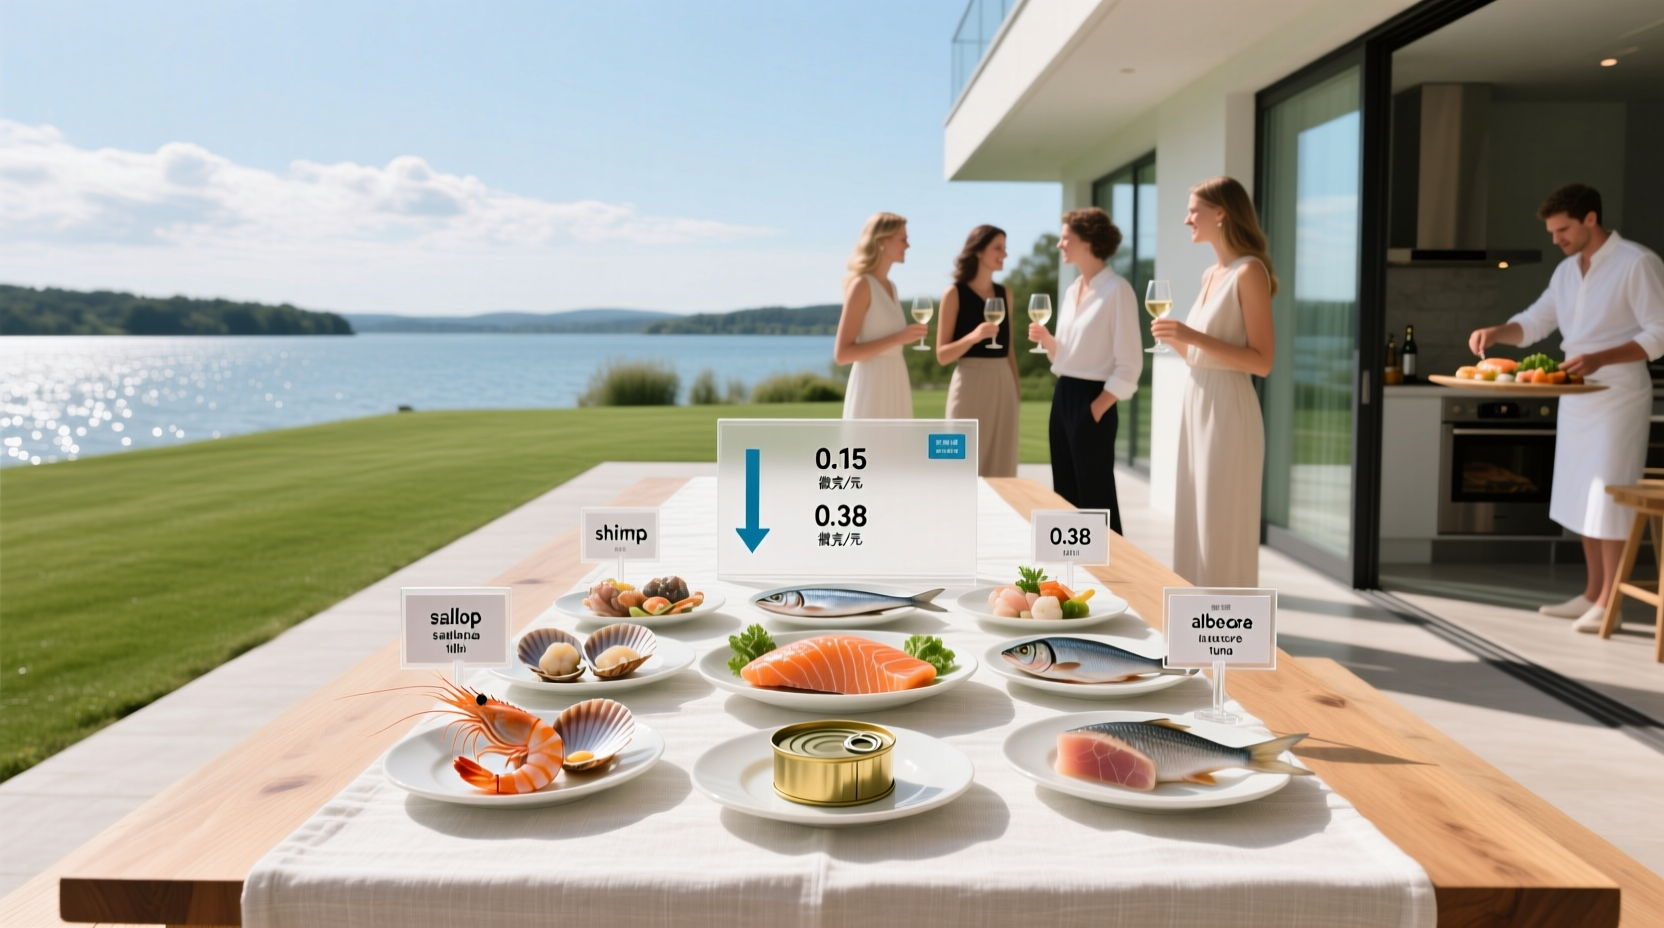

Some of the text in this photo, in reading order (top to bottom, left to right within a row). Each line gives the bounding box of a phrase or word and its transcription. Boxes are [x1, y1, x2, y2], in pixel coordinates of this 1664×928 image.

[816, 447, 867, 470] 0.15
[815, 504, 867, 527] 0.38
[595, 524, 648, 545] shimp
[1050, 527, 1091, 545] 0.38
[430, 607, 482, 629] sallop
